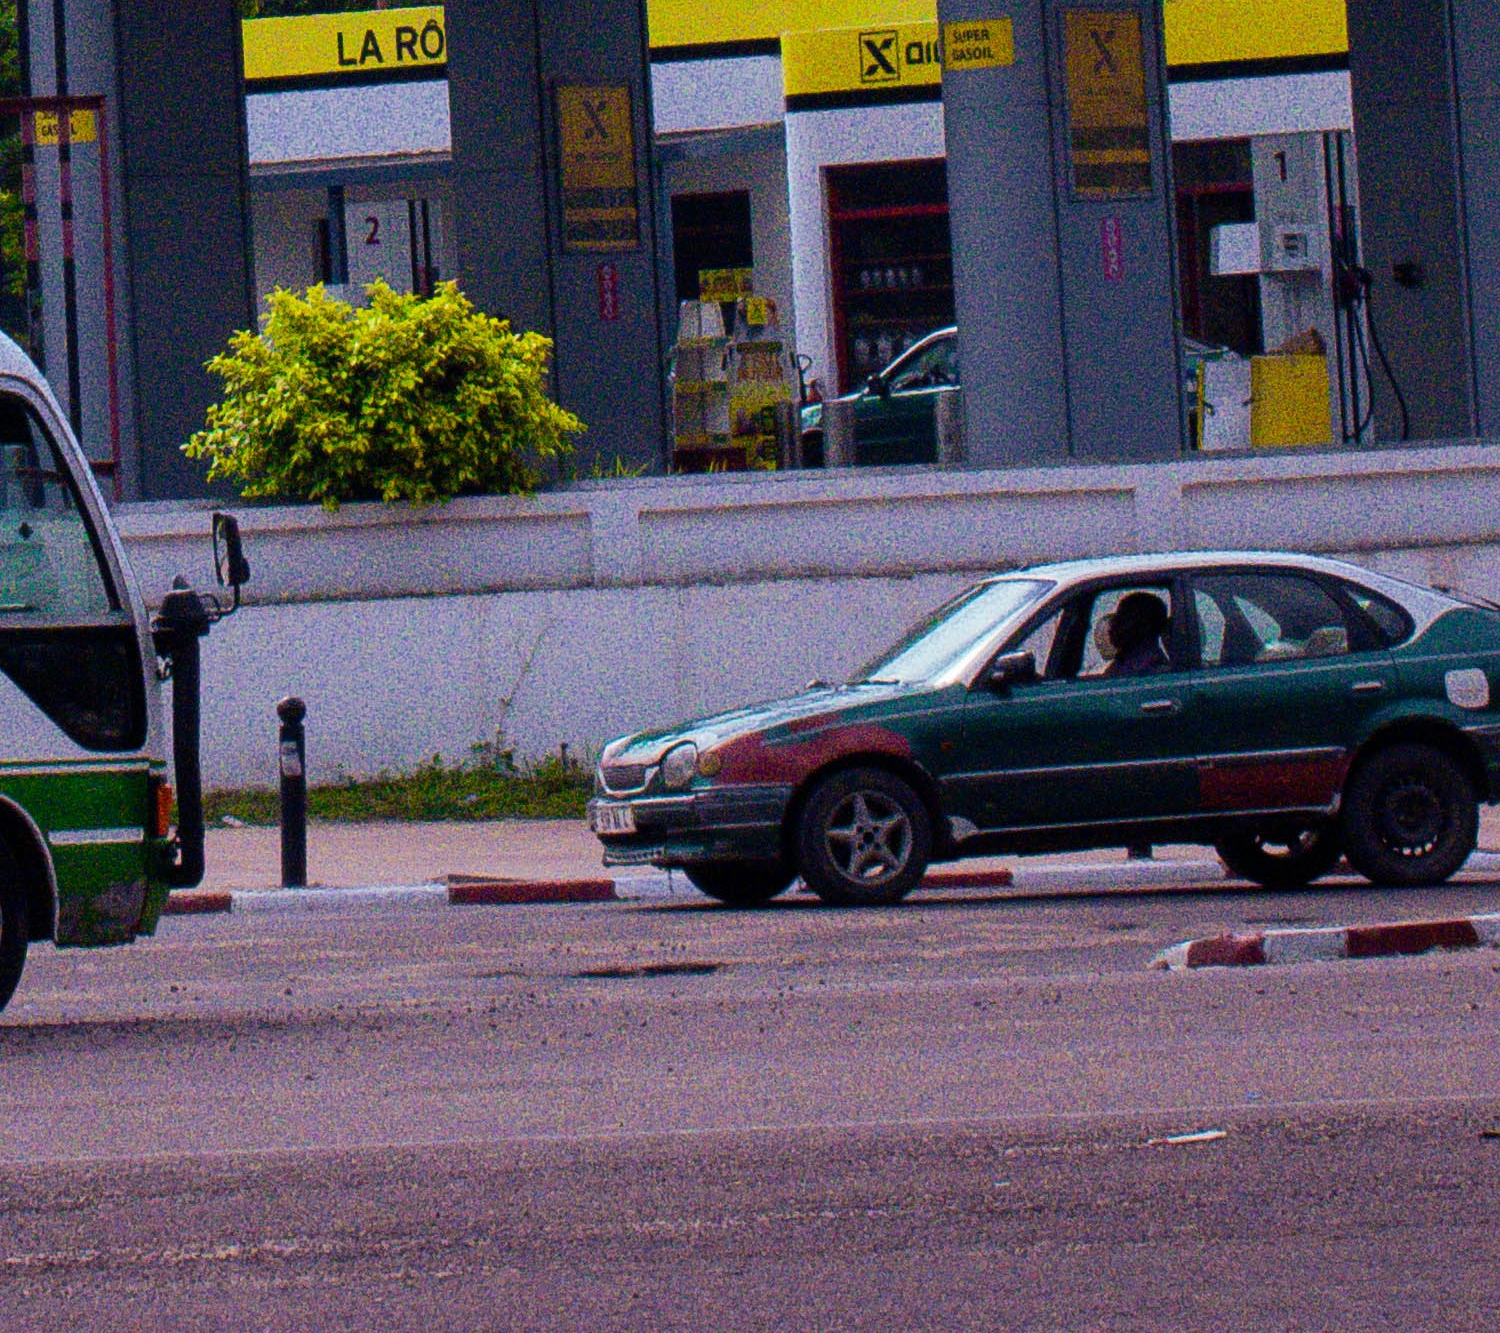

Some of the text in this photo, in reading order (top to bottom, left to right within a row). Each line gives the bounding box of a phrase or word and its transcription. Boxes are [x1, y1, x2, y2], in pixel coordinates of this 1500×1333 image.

[952, 29, 989, 43] SUPER
[337, 29, 383, 66] LA
[952, 47, 994, 61] GASOIL
[365, 216, 381, 244] 2
